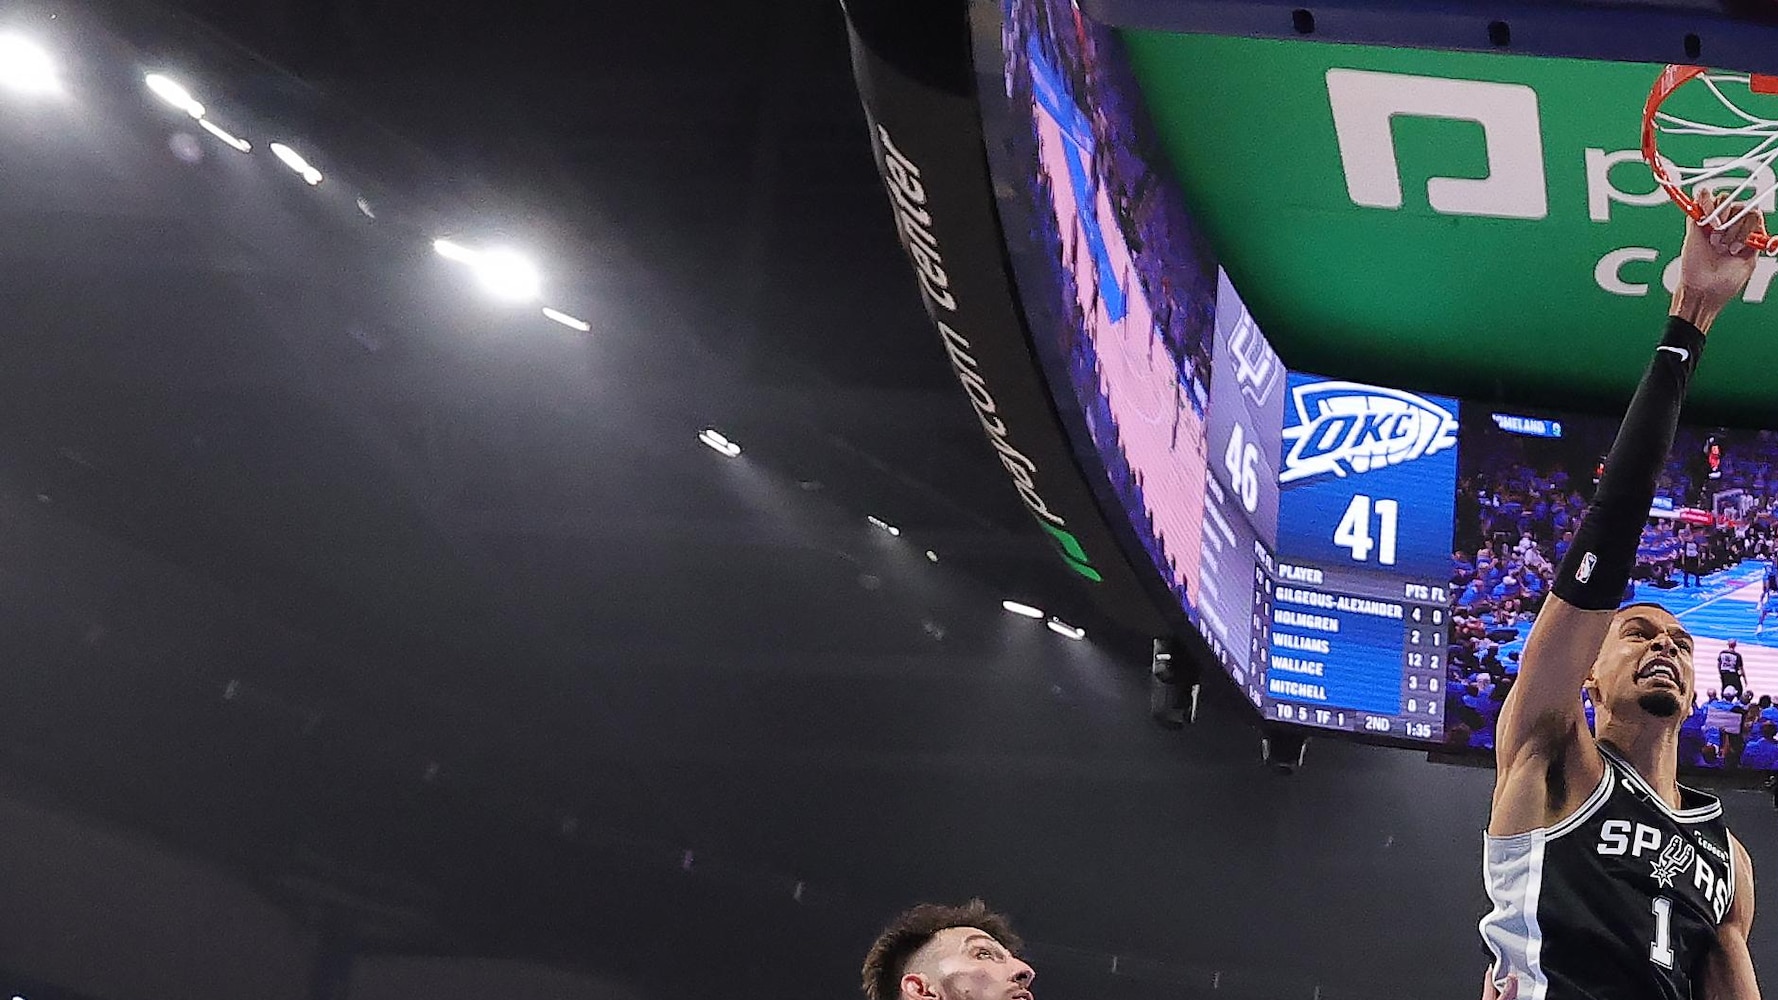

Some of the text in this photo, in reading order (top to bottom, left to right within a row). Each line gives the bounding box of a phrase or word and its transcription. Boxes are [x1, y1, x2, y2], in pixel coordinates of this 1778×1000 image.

[877, 124, 1067, 527] paycom center
[1225, 420, 1259, 513] 46
[1333, 494, 1398, 566] 41
[1278, 564, 1446, 602] PLAYER PTS FL
[1275, 587, 1442, 625] GILGEOUS-ALEXANDER 4 0
[1274, 609, 1441, 647] HOLMGREN 2 1
[1272, 632, 1439, 669] WILLIAMS 12 2
[1271, 655, 1439, 692] WALLACE 3 0
[1269, 678, 1437, 715] MITCHELL 0 2
[1276, 703, 1432, 739] TO 5 TF 1 2ND 1:35
[1650, 896, 1675, 971] 1
